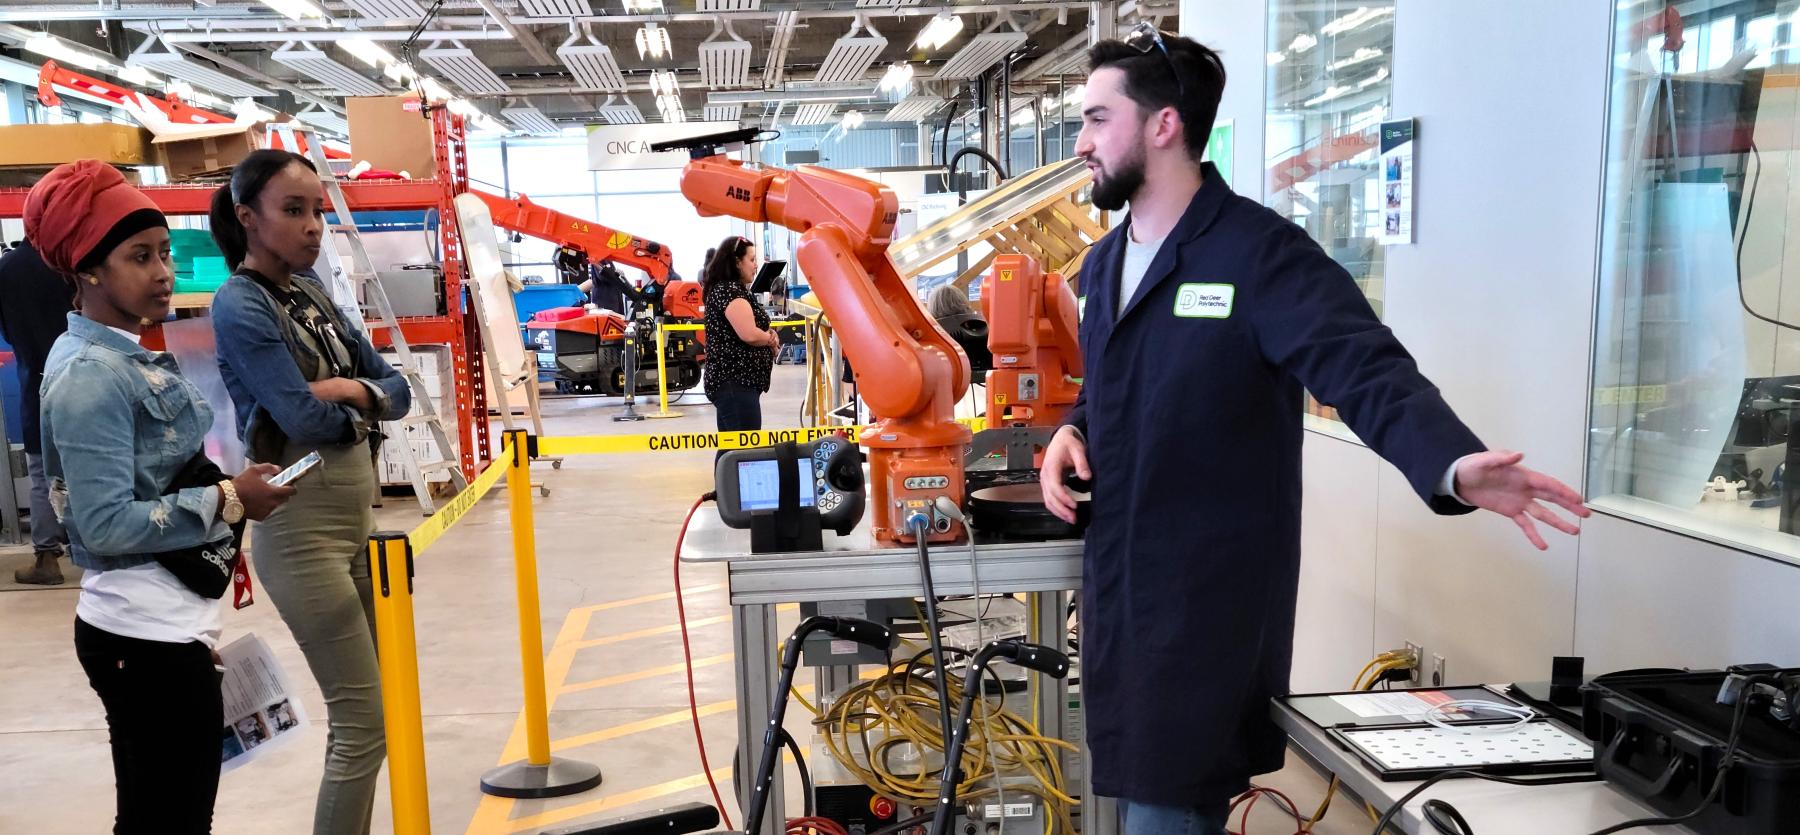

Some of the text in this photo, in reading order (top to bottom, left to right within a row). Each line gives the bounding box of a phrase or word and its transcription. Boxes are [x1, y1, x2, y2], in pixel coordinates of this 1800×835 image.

[606, 140, 637, 155] CNC
[726, 185, 751, 202] ABB
[649, 433, 719, 451] CAUTION
[739, 431, 761, 446] DO
[768, 430, 800, 445] NOT
[807, 427, 855, 441] ENTR
[201, 550, 229, 577] adidas
